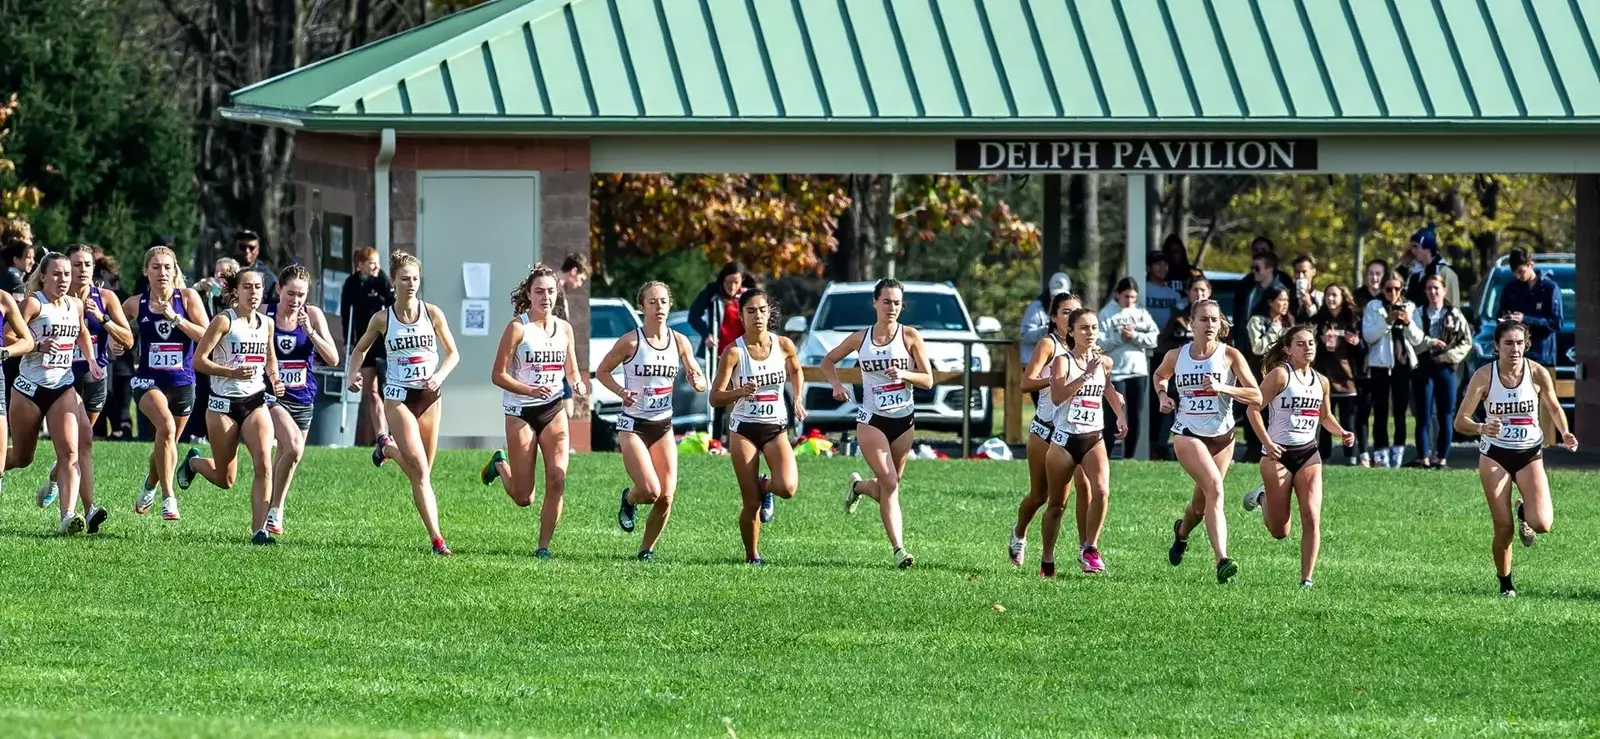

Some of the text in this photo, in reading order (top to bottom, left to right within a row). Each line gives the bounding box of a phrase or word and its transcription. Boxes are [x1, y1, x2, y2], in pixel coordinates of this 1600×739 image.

[978, 141, 1296, 169] DELPH PAVILION
[42, 324, 80, 338] LEHIG
[231, 342, 267, 355] LEHIG
[388, 335, 433, 351] LEHIGH
[48, 354, 70, 365] 228
[154, 354, 178, 366] 215
[862, 358, 908, 373] EHIGH
[279, 371, 301, 383] 208
[404, 366, 427, 380] 241
[534, 373, 556, 385] 234
[15, 378, 31, 392] 228
[1177, 373, 1221, 387] LEHIH
[385, 386, 401, 398] 241
[1073, 384, 1105, 397] EHIG
[208, 398, 225, 410] 238
[649, 397, 670, 409] 232
[878, 393, 904, 408] 236
[1189, 399, 1214, 411] 242
[1281, 396, 1322, 409] LEHIG
[750, 403, 774, 416] 240
[1489, 400, 1534, 415] LEHIGH
[857, 410, 868, 422] 36
[1073, 409, 1096, 423] 243
[1294, 418, 1315, 430] 229
[1503, 427, 1528, 439] 230
